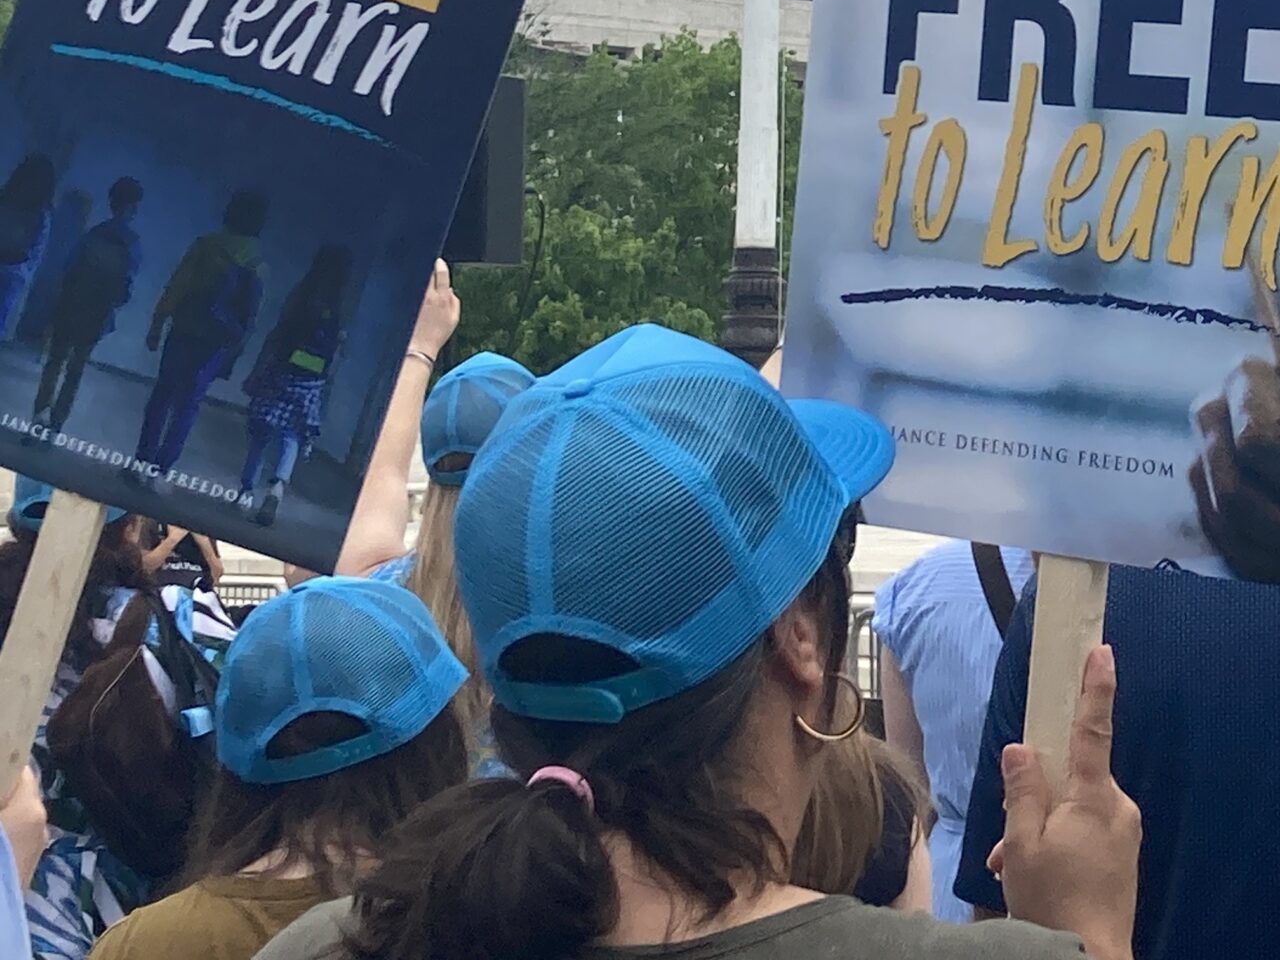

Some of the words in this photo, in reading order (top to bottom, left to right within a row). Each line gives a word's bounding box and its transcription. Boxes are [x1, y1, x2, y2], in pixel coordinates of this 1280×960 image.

[872, 65, 968, 249] to
[53, 432, 161, 478] DEFENDING
[165, 469, 255, 508] FREEDOM
[955, 434, 1069, 464] DEFENDING
[1078, 450, 1175, 478] FREEDOM
